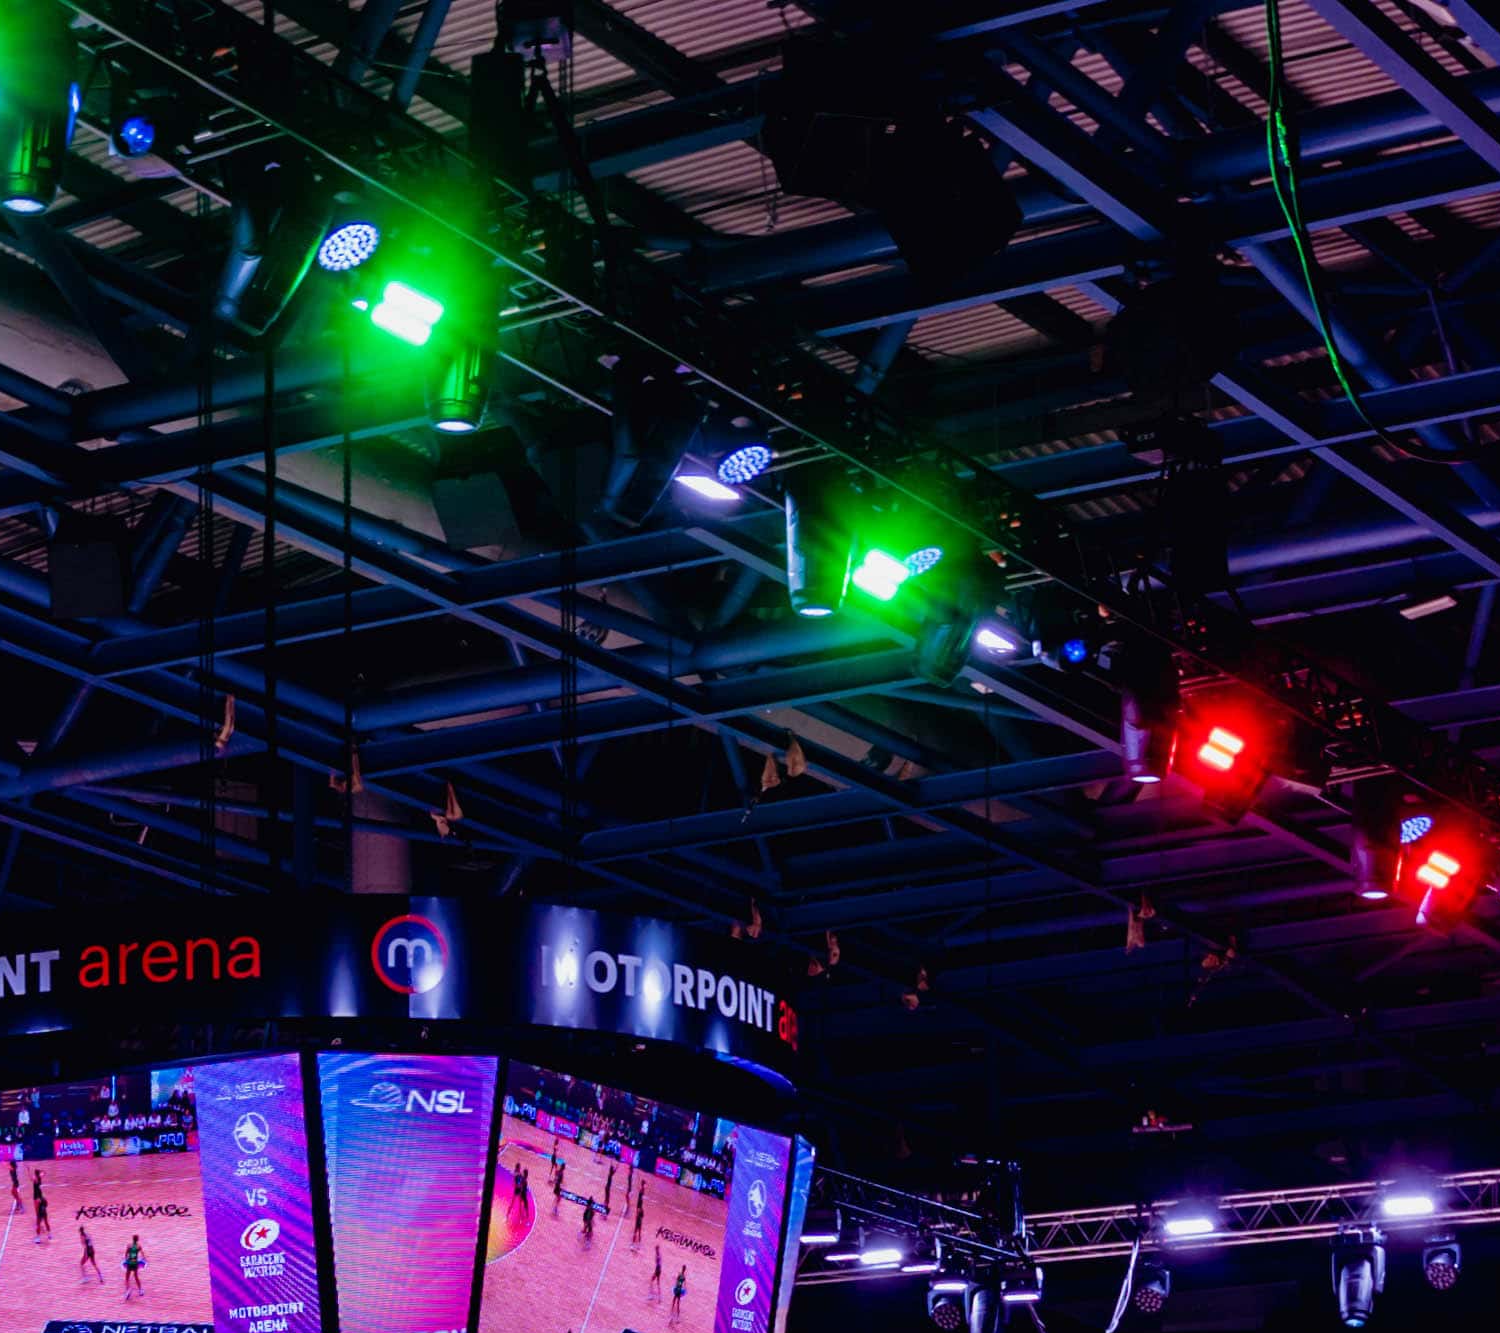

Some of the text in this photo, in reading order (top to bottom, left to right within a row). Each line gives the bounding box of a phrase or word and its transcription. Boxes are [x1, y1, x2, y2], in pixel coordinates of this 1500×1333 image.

[78, 935, 260, 988] arena
[405, 1089, 473, 1114] NSL
[245, 1187, 268, 1207] VS
[229, 1301, 304, 1320] MOTORPOINT
